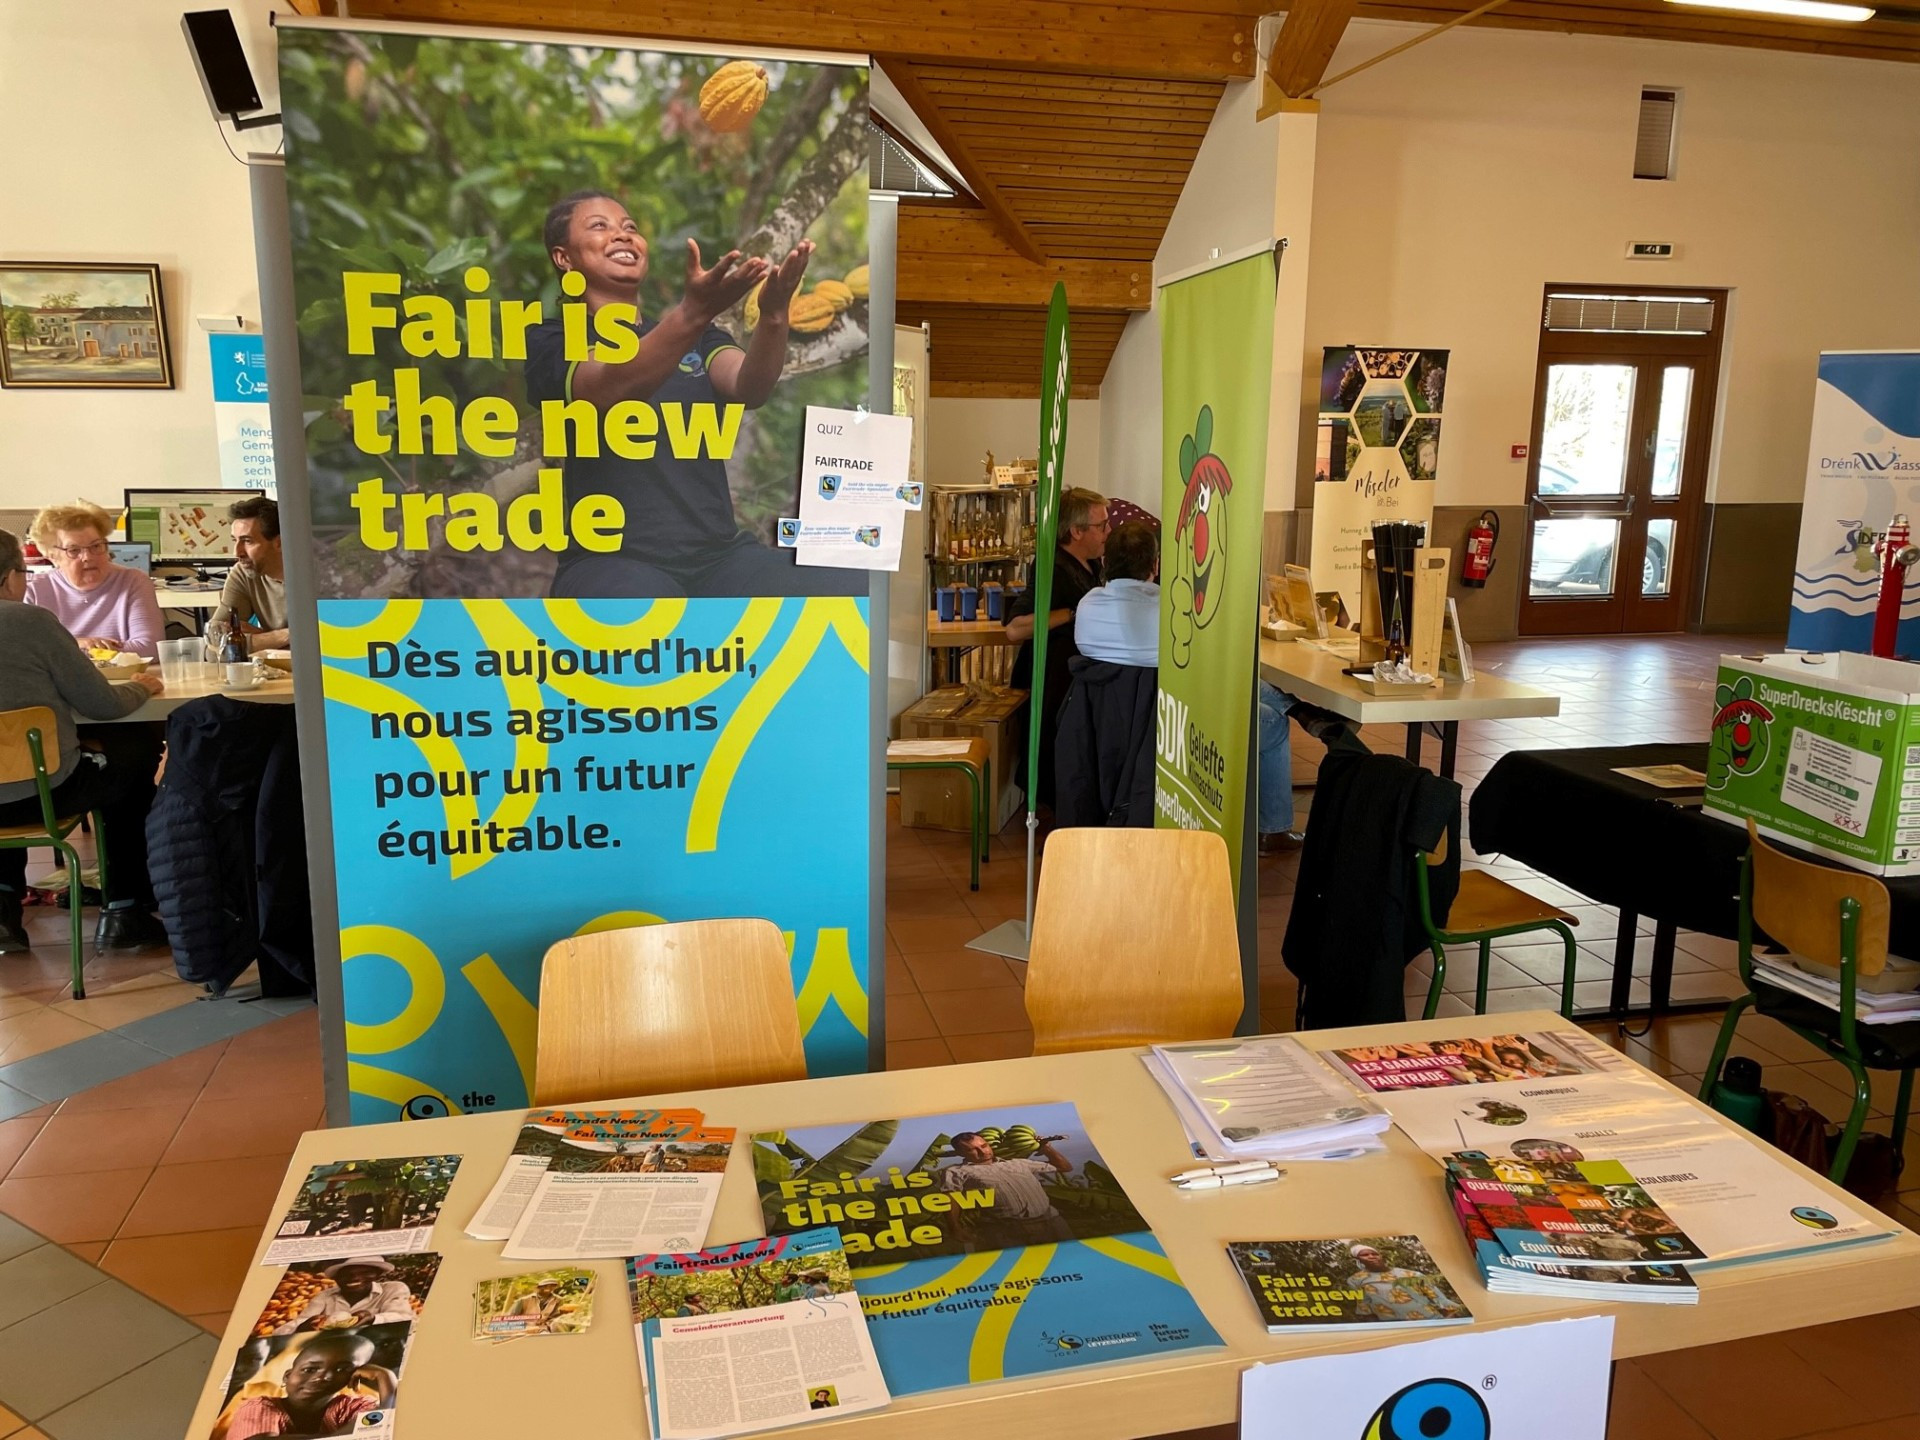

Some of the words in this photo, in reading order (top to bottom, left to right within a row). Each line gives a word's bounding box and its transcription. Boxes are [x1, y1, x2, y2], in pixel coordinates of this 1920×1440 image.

[342, 266, 542, 360] Fair
[561, 270, 640, 364] is
[344, 368, 519, 458] the
[540, 396, 746, 460] new
[817, 423, 843, 435] QUIZ
[242, 440, 273, 450] Gem
[243, 455, 273, 464] enga
[815, 455, 873, 471] FAIRTRADE
[244, 467, 271, 475] sech
[350, 468, 626, 552] trade
[1386, 497, 1399, 507] Bei
[366, 639, 461, 679] Dès
[474, 637, 758, 685] aujourd'hui,
[1759, 683, 1883, 728] SuperDrecksKëscht
[371, 709, 492, 740] nous
[505, 698, 719, 744] agissons
[1156, 687, 1188, 776] SDK
[1189, 722, 1225, 784] Geliefte
[375, 767, 491, 808] pour
[503, 766, 562, 796] un
[574, 755, 696, 793] futur
[377, 815, 622, 866] équitable.
[1352, 1062, 1383, 1072] LES
[1381, 1055, 1463, 1070] GARANTIES
[1366, 1070, 1450, 1087] FAIRTRADE
[461, 1091, 496, 1107] the
[545, 1116, 609, 1125] Fairtrade
[573, 1130, 638, 1139] Fairtrade
[1498, 1163, 1536, 1181] 25
[779, 1172, 881, 1199] Fair
[887, 1167, 933, 1190] is
[1466, 1181, 1533, 1194] QUESTIONS
[782, 1198, 876, 1227] the
[886, 1188, 995, 1216] new
[1577, 1199, 1605, 1208] SUR
[1542, 1221, 1615, 1233] COMMERCE
[842, 1219, 943, 1254] ade
[1519, 1241, 1590, 1256] ÉQUITABLE
[654, 1255, 731, 1271] Fairtrade
[732, 1248, 776, 1262] News
[955, 1282, 1000, 1295] nous
[1003, 1272, 1083, 1291] agissons
[1257, 1272, 1306, 1288] Fair
[1308, 1272, 1332, 1287] is
[1264, 1288, 1308, 1302] the
[1311, 1289, 1364, 1301] new
[865, 1312, 877, 1322] n
[881, 1307, 929, 1321] futur
[934, 1294, 1027, 1314] équitable.
[1271, 1302, 1343, 1317] trade
[673, 1314, 785, 1334] Gemeindeverantwortung
[1148, 1323, 1169, 1331] the
[1153, 1327, 1190, 1337] future
[1085, 1331, 1143, 1343] FAIRTRADE
[1168, 1333, 1190, 1341] fair
